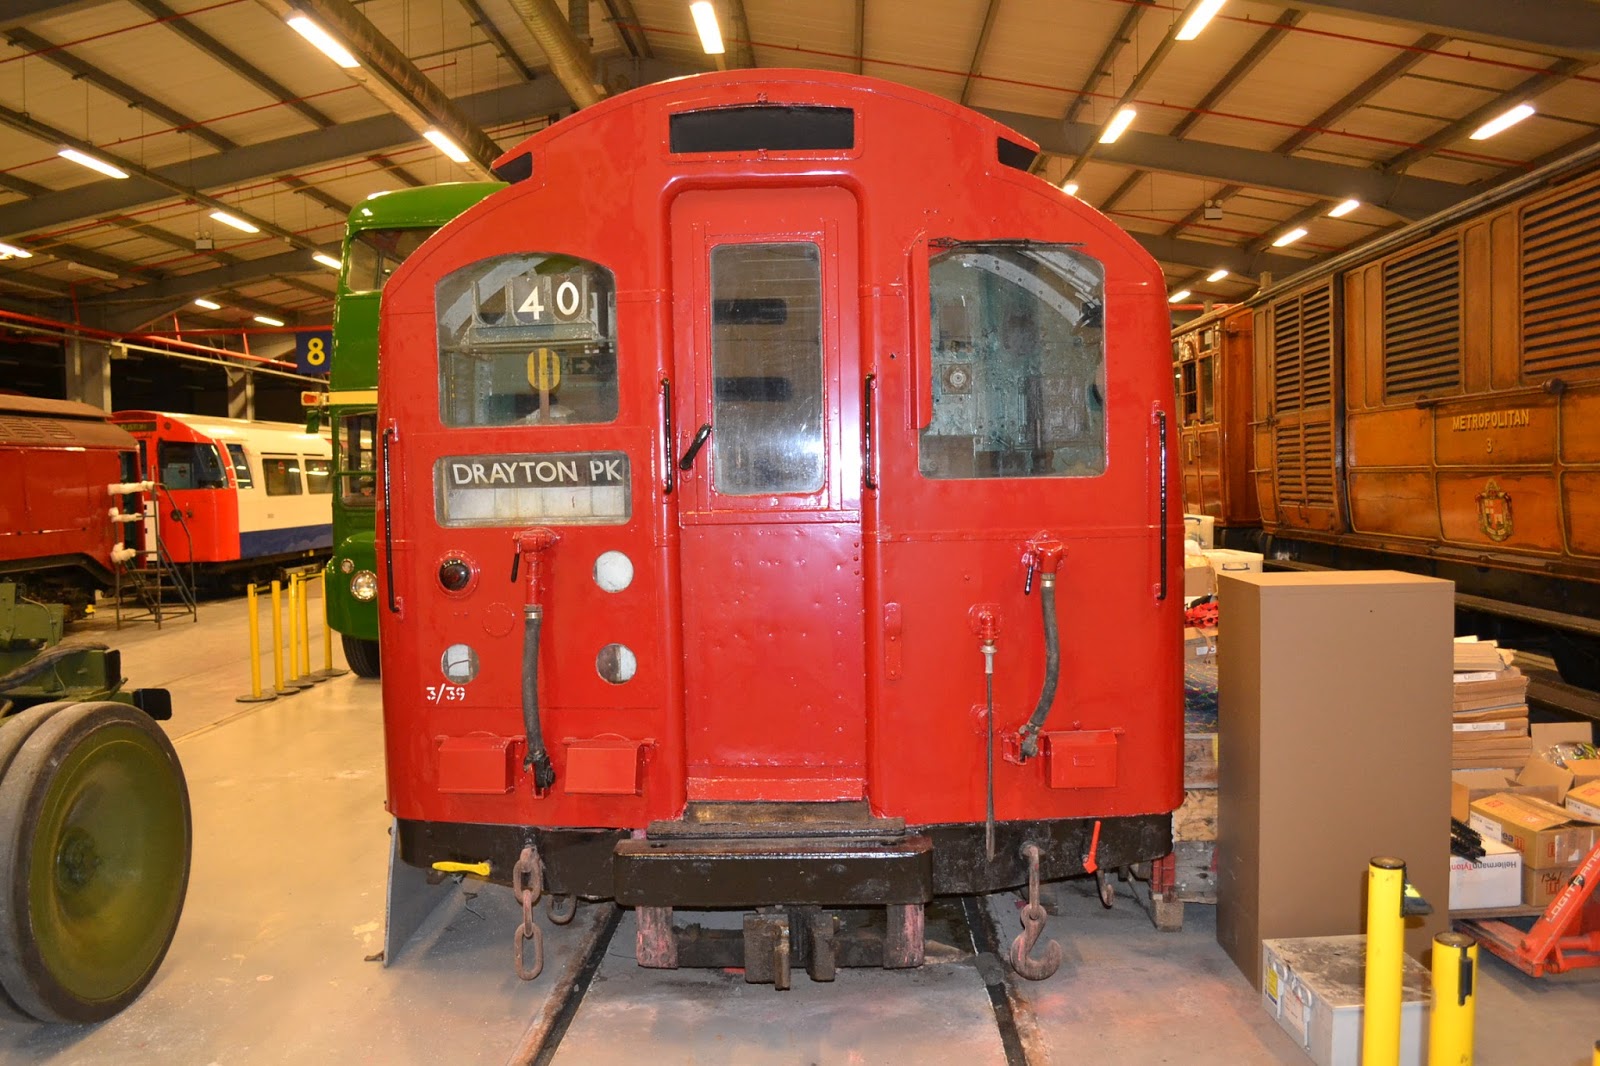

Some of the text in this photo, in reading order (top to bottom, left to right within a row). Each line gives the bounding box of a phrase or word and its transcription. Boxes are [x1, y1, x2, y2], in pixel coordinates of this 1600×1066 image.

[517, 281, 580, 321] 40
[307, 337, 326, 366] 8
[1452, 409, 1530, 432] METROPOLITAN
[1486, 438, 1494, 454] 3
[452, 460, 623, 484] DRAYTON PK
[426, 683, 466, 705] 3/39
